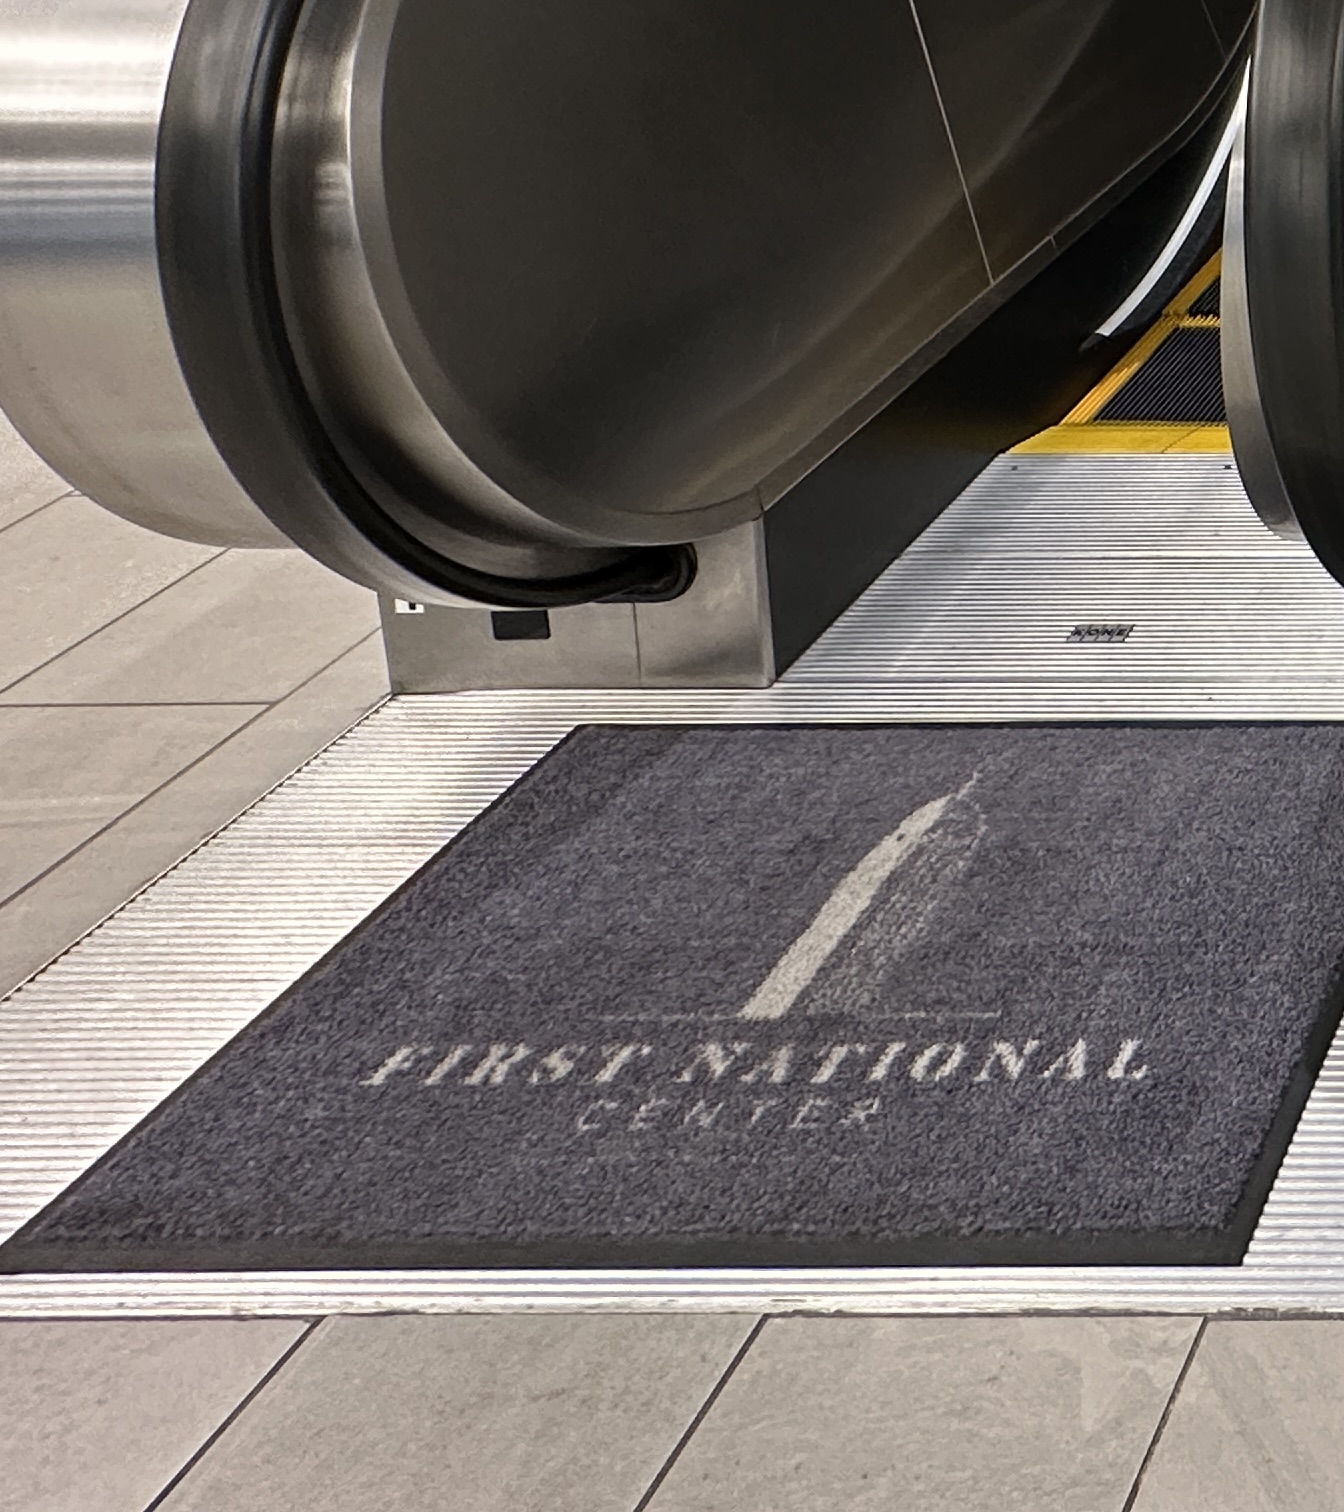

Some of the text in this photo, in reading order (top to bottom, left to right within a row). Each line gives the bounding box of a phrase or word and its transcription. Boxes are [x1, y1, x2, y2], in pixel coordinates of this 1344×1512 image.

[358, 1038, 1150, 1087] FIRST NATIONAL
[576, 1095, 883, 1133] CENTER
